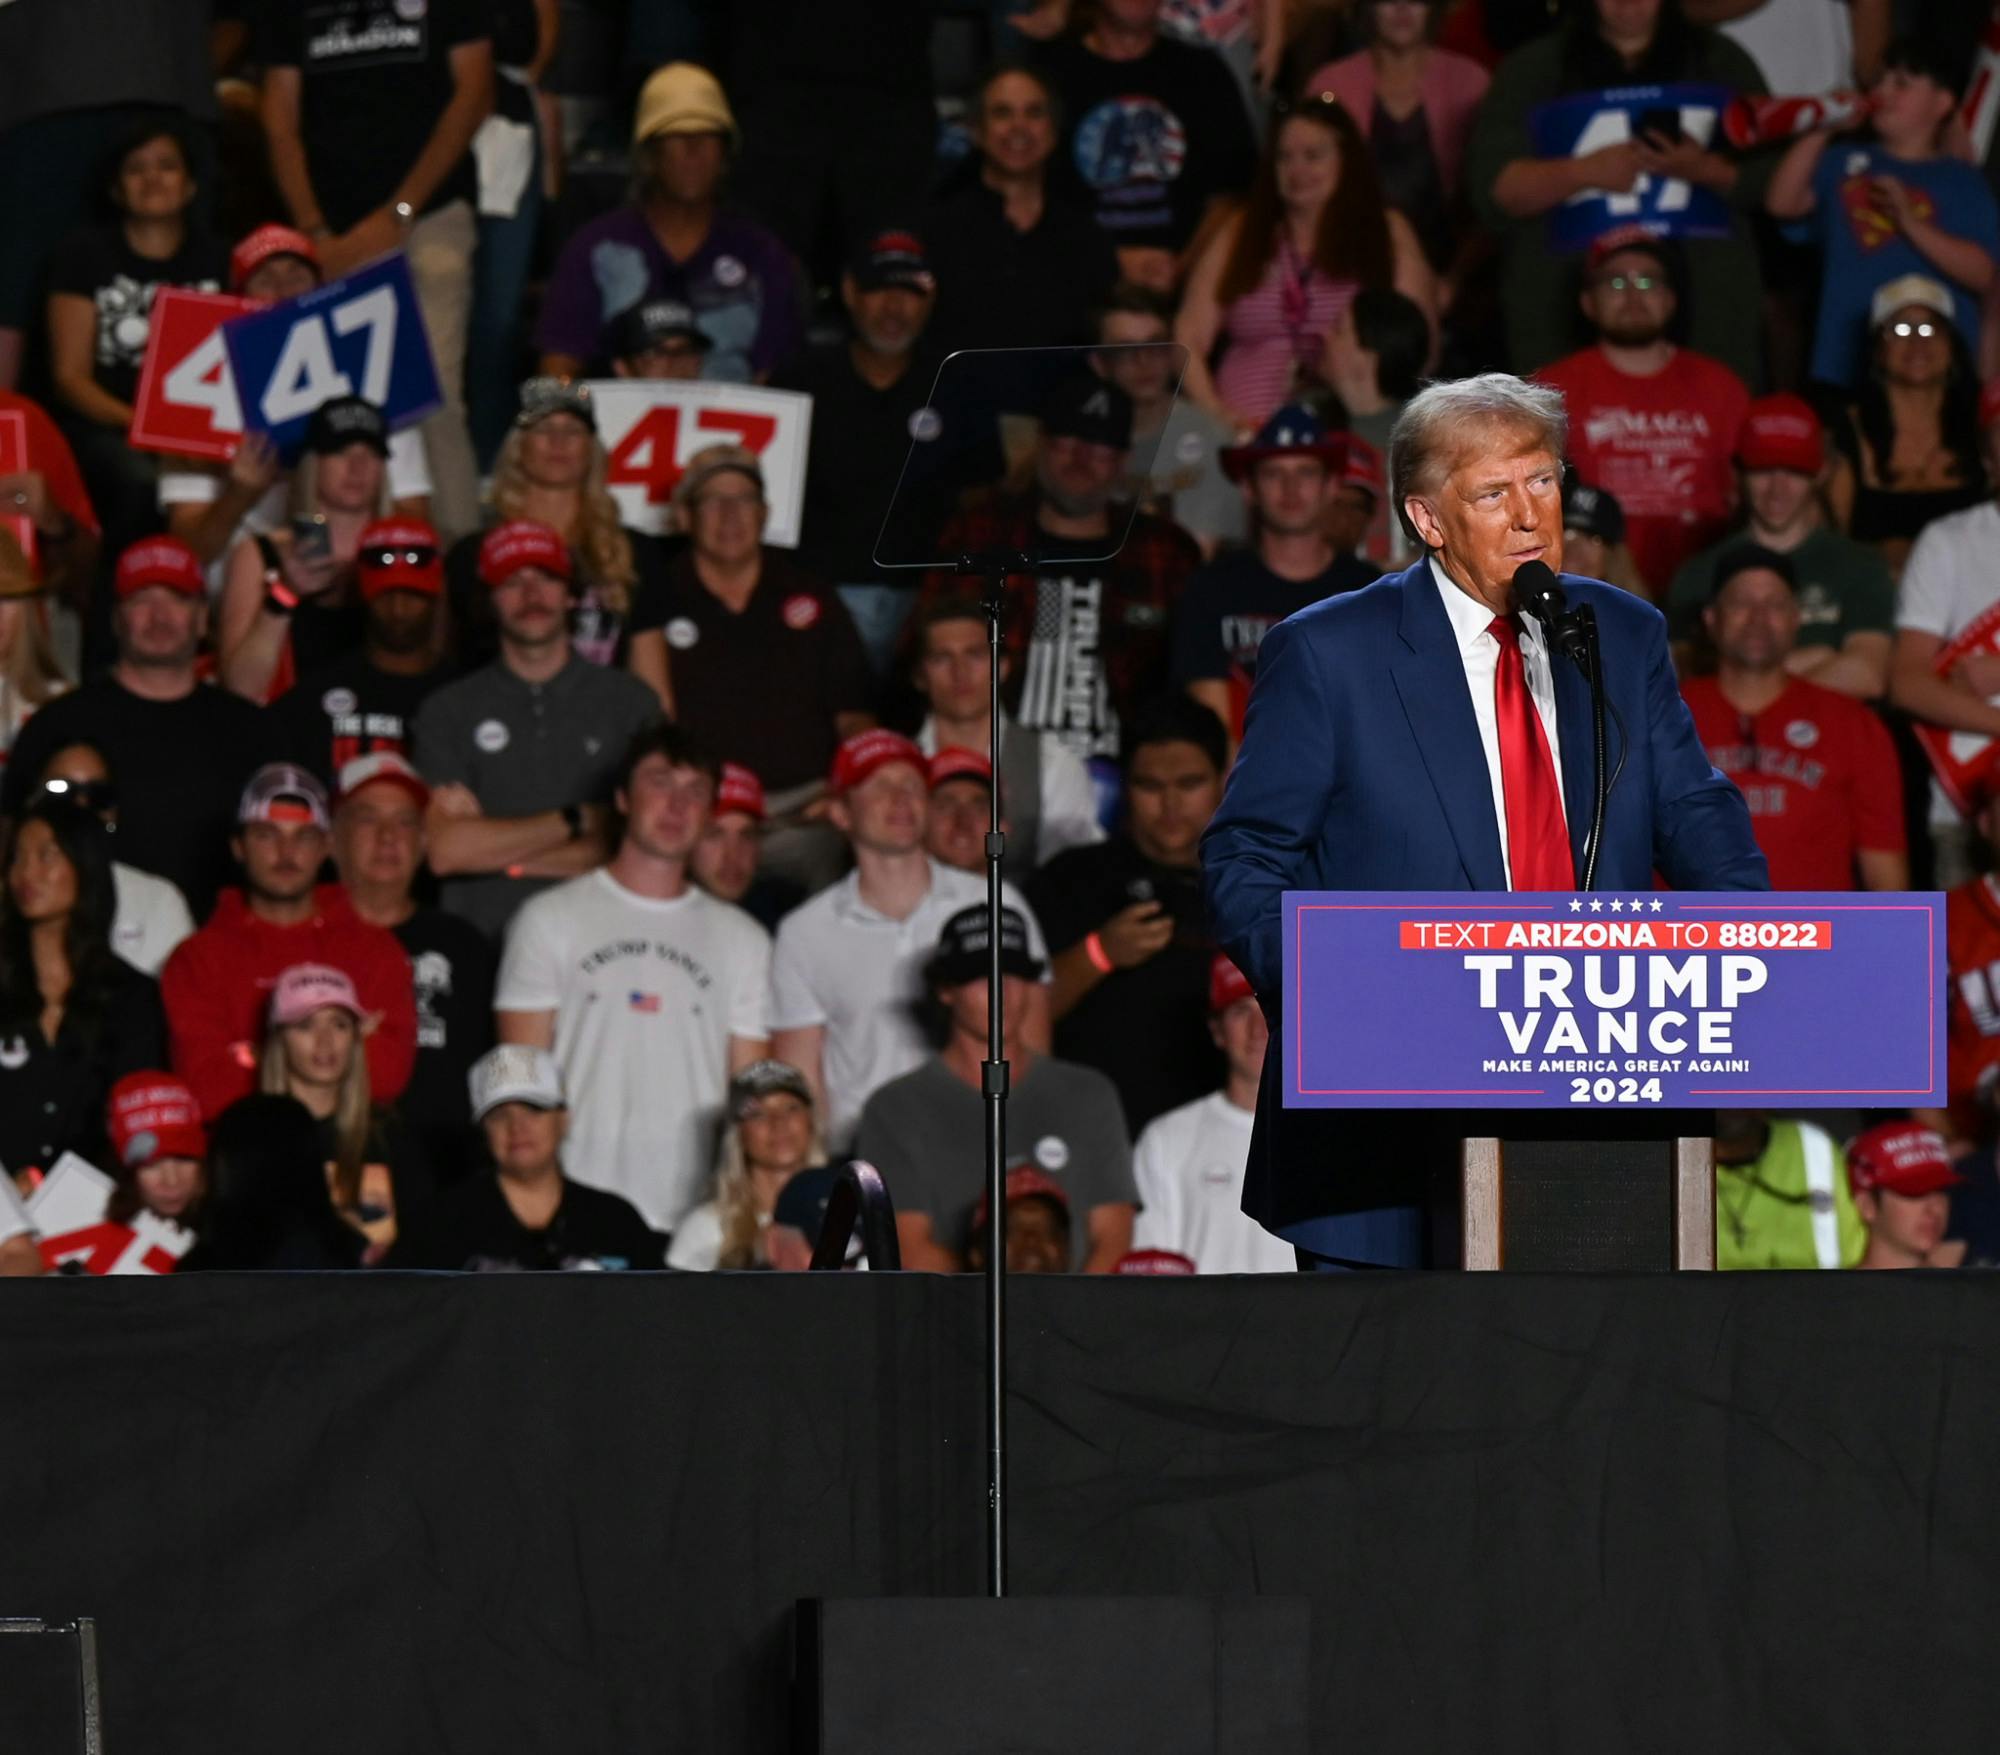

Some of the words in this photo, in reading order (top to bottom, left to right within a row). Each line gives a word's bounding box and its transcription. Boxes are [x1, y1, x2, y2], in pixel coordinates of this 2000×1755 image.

[259, 281, 399, 427] 47
[606, 405, 778, 504] 47
[1413, 922, 1496, 948] TEXT
[1505, 922, 1657, 948] ARIZONA
[1665, 922, 1709, 948] TO
[1718, 922, 1818, 948] 88022
[1464, 955, 1768, 1009] TRUMP
[1498, 1010, 1734, 1055] VANCE
[1483, 1059, 1532, 1073] MAKE
[1538, 1059, 1618, 1073] AMERICA
[1624, 1059, 1682, 1073] GREAT
[1687, 1059, 1750, 1073] AGAIN!
[1570, 1077, 1663, 1103] 2024
